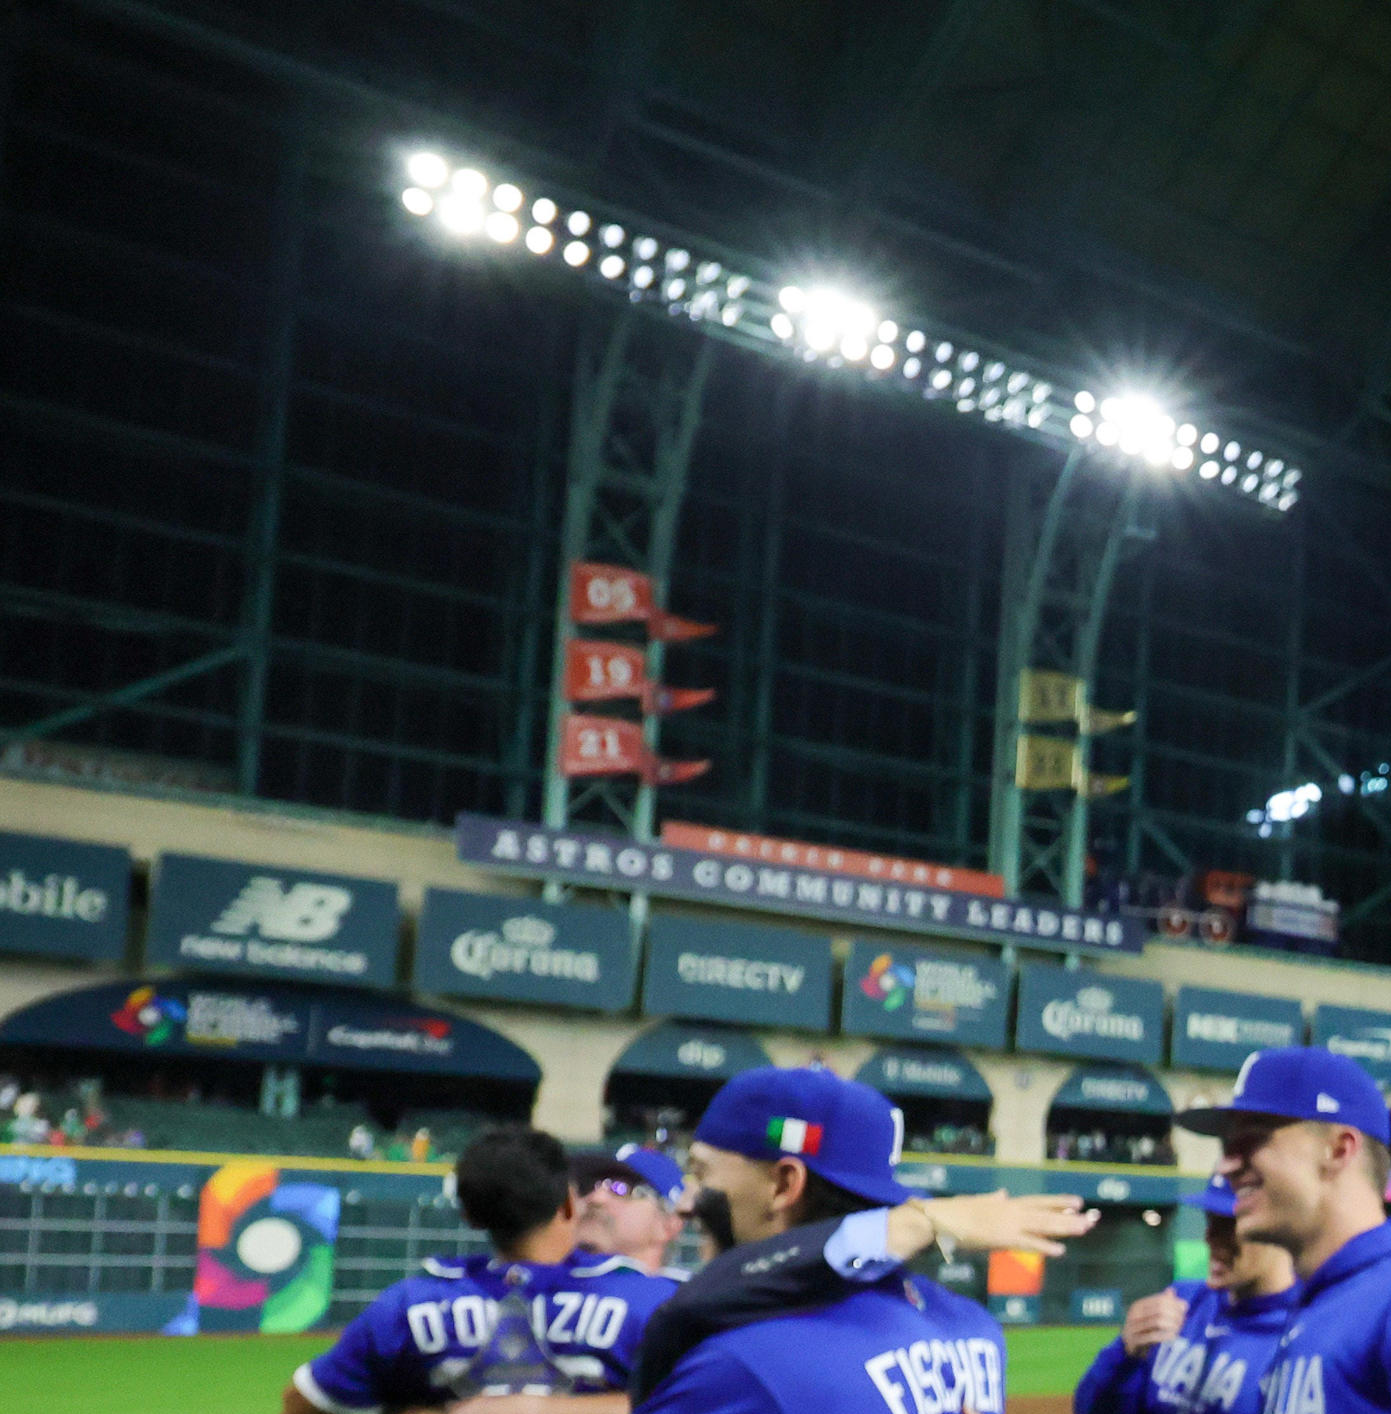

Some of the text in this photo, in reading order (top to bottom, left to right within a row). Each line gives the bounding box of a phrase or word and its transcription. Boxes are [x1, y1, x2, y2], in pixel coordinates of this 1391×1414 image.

[0, 868, 106, 922] bile
[491, 829, 1124, 947] ASTROS COMMUNITY LEADERS
[450, 930, 600, 982] Corona
[677, 951, 805, 994] DIRECTV
[1042, 1000, 1145, 1041] Corona
[407, 1291, 628, 1354] D'OZIO
